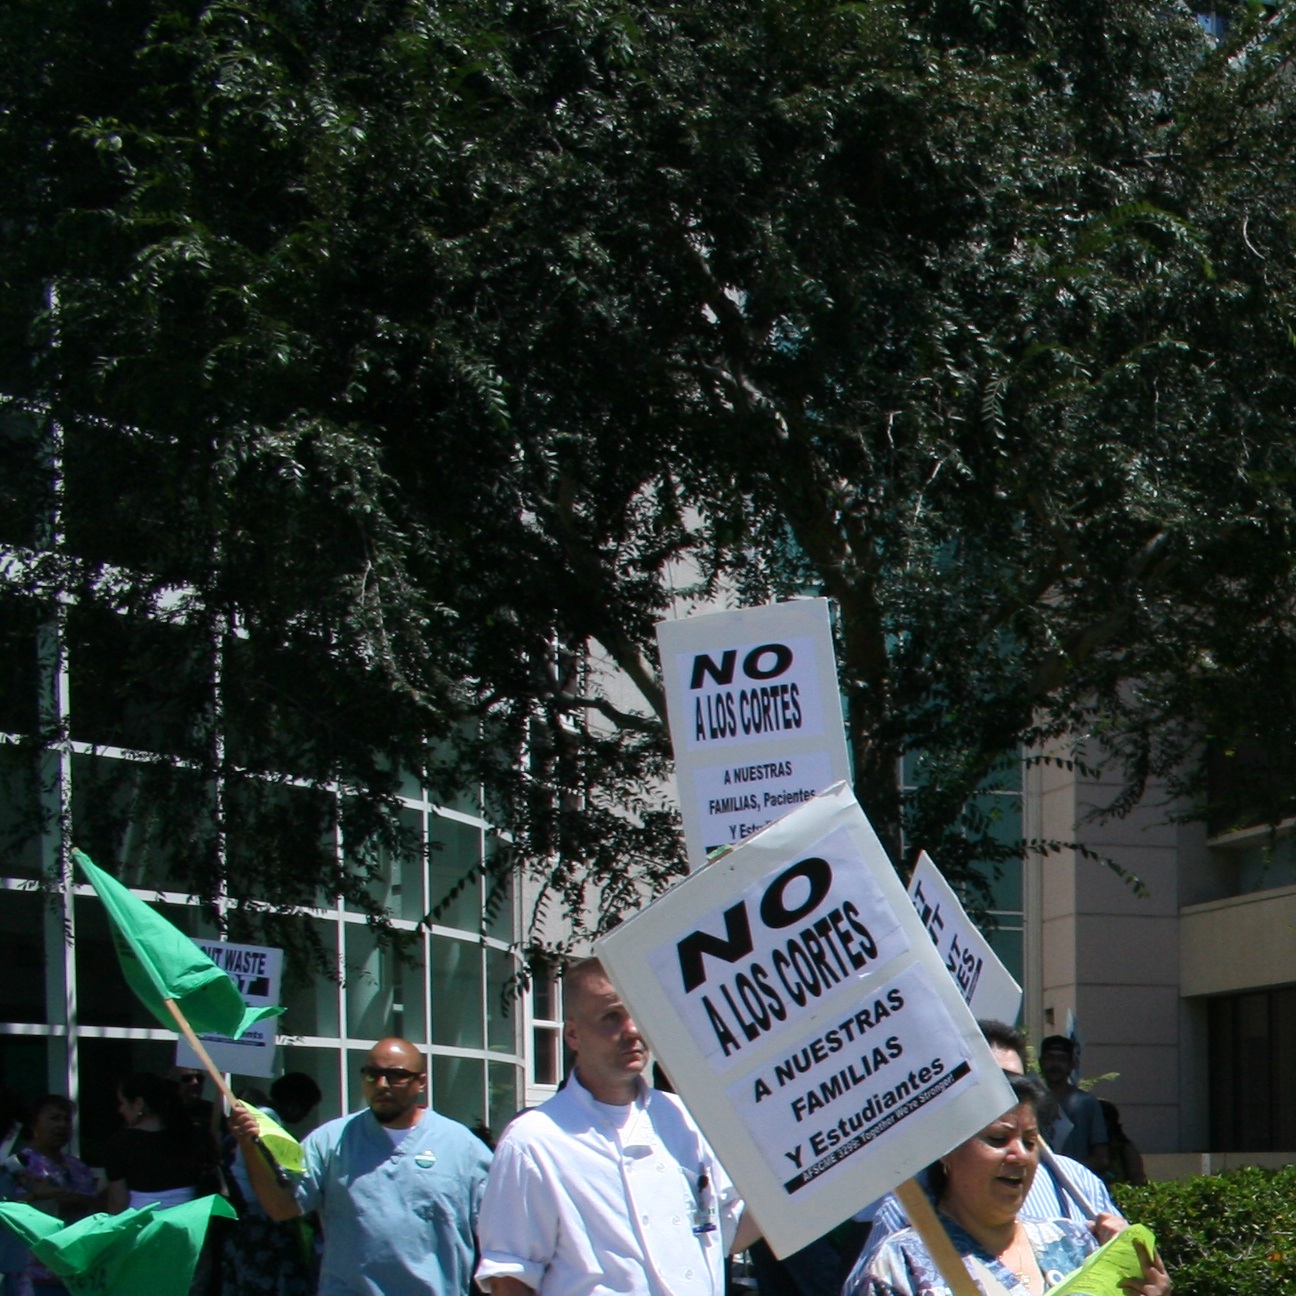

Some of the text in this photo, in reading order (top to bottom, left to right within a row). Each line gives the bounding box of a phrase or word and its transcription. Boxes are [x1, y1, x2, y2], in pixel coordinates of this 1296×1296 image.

[690, 643, 793, 689] NO
[696, 683, 802, 741] A LOS CORTES
[709, 788, 816, 815] FAMILIAS, Pacientes
[724, 761, 793, 785] A NUESTRAS
[729, 825, 737, 840] Y
[677, 857, 833, 994] NO
[772, 901, 878, 1007] CORTES
[224, 948, 267, 975] WASTE
[701, 995, 741, 1057] A
[720, 963, 787, 1042] LOS
[755, 988, 905, 1103] A NUESTRAS
[790, 1036, 904, 1122] FAMILIAS
[784, 1057, 945, 1169] Y Estudiantes
[859, 1114, 897, 1143] Together
